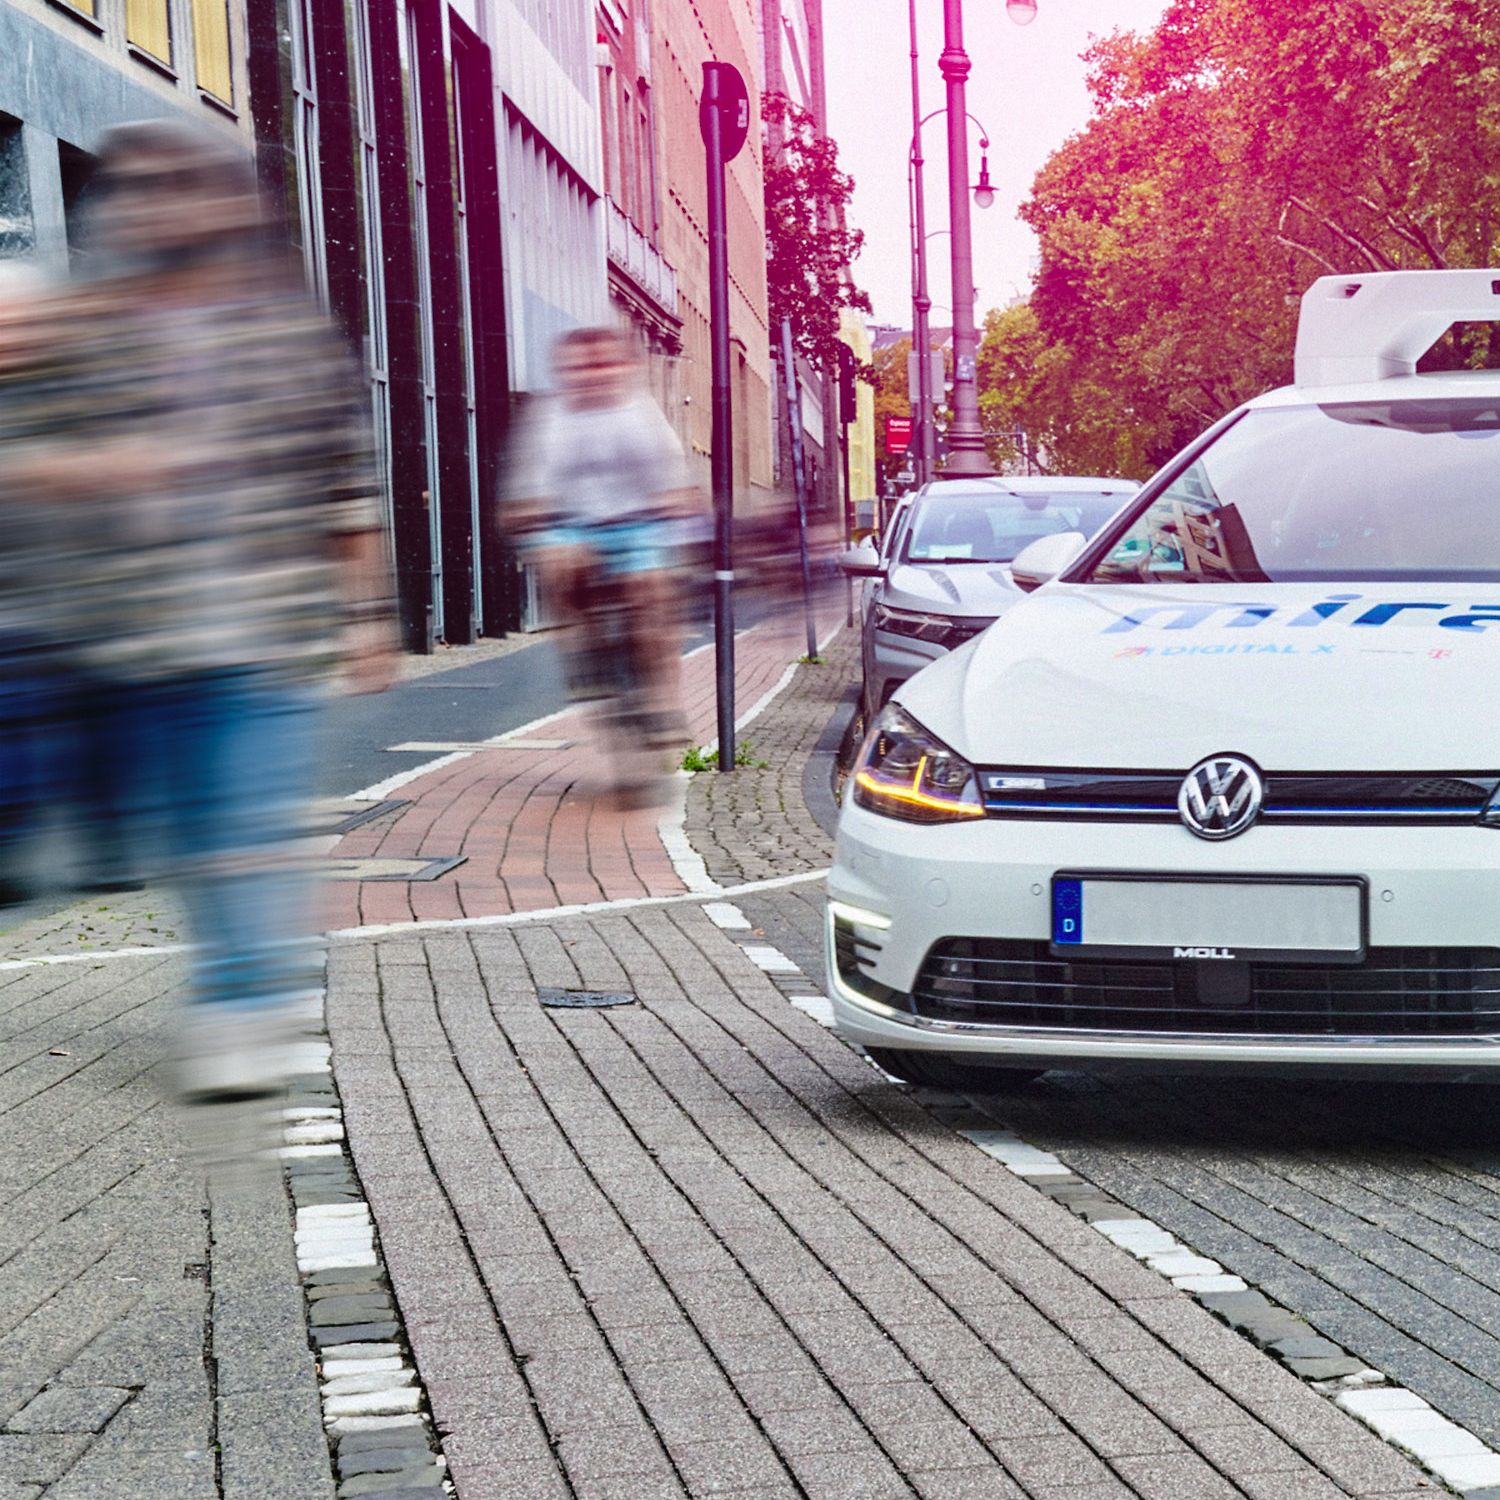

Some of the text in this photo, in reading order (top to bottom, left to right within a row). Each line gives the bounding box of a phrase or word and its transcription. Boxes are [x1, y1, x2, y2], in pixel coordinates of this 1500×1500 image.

[1160, 643, 1338, 656] DIGITAL X
[1063, 918, 1075, 933] D
[1173, 947, 1236, 959] MOLL
